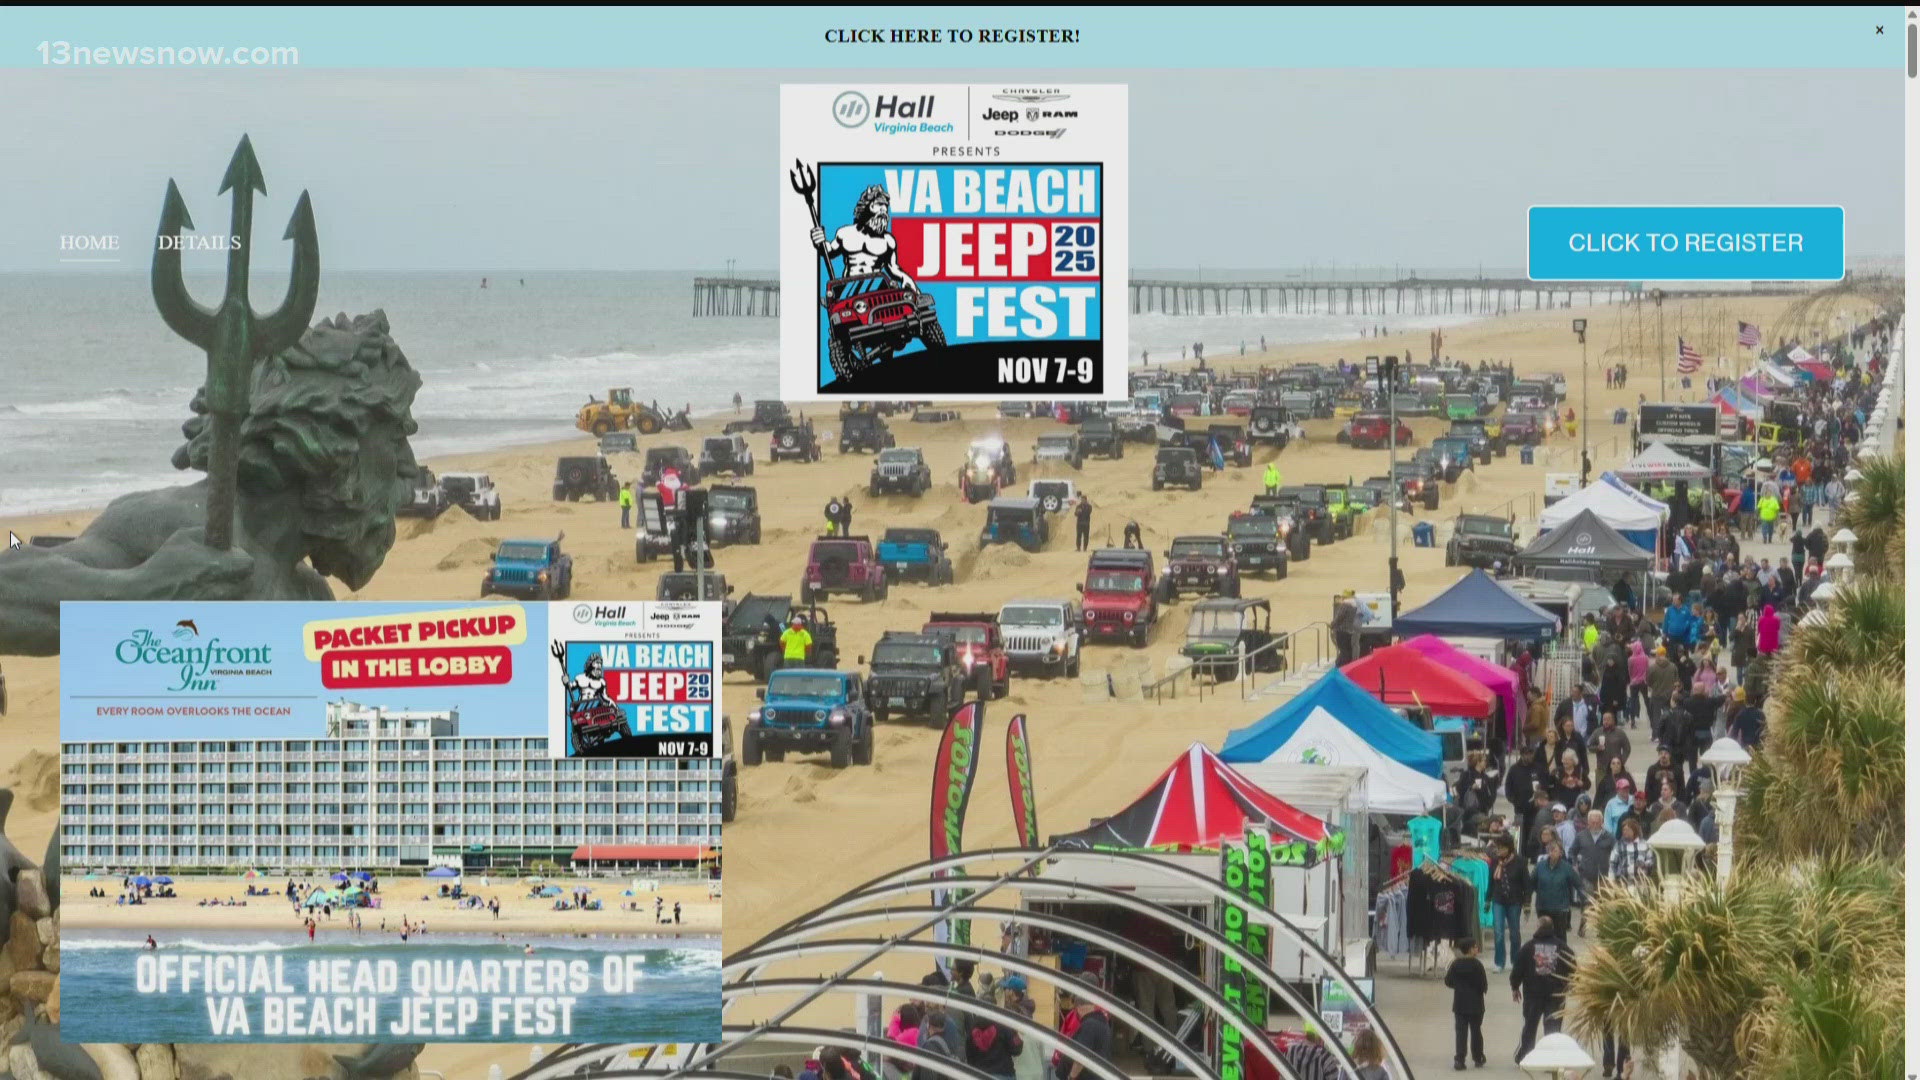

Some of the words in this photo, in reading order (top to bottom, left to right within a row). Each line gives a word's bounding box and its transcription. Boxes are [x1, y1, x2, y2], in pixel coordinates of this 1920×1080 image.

[825, 29, 885, 43] CLICK
[890, 29, 942, 43] HERE
[948, 29, 973, 43] TO
[979, 29, 1080, 43] REGISTER!
[875, 95, 935, 118] Hall
[982, 107, 1020, 123] Jeep
[874, 122, 917, 135] Virginia
[920, 122, 953, 133] Beach
[932, 146, 1001, 157] PRESENTS
[885, 169, 942, 213] VA
[954, 169, 1095, 213] BEACH
[60, 235, 120, 250] HOME
[158, 235, 242, 250] DETAILS
[1055, 225, 1095, 247] 20
[1568, 233, 1640, 252] CLICK
[1646, 233, 1679, 252] TO
[1685, 233, 1804, 252] REGISTER
[917, 223, 1047, 277] JEEP
[1055, 251, 1095, 272] 25
[956, 286, 1096, 338] FEST
[998, 357, 1048, 383] NOV
[1055, 357, 1093, 383] 7-9
[1568, 546, 1596, 554] Hall
[595, 606, 626, 619] Hall
[650, 612, 670, 621] Jeep
[314, 623, 412, 650] PACKET
[418, 615, 516, 641] PICKUP
[595, 620, 616, 628] Virginia
[131, 629, 162, 647] The
[115, 638, 272, 676] Oceanfront
[600, 645, 631, 667] VA
[635, 645, 710, 667] BEACH
[167, 663, 217, 692] Inn
[331, 659, 359, 679] IN
[365, 657, 412, 678] THE
[418, 655, 503, 676] LOBBY
[617, 673, 684, 700] JEEP
[688, 674, 709, 685] 20
[688, 687, 709, 698] 25
[96, 707, 129, 716] EVERY
[131, 707, 164, 716] ROOM
[166, 707, 230, 716] OVERLOOKS
[232, 707, 251, 716] THE
[254, 707, 291, 716] OCEAN
[636, 705, 709, 732] FEST
[658, 742, 684, 756] NOV
[688, 742, 708, 756] 7-9
[136, 956, 294, 993] OFFICIAL
[308, 960, 398, 993] HEAD
[411, 960, 589, 996] QUARTERS
[602, 956, 646, 993] OF
[206, 997, 250, 1035] VA
[263, 997, 377, 1035] BEACH
[390, 997, 478, 1035] JEEP
[491, 997, 577, 1035] FEST
